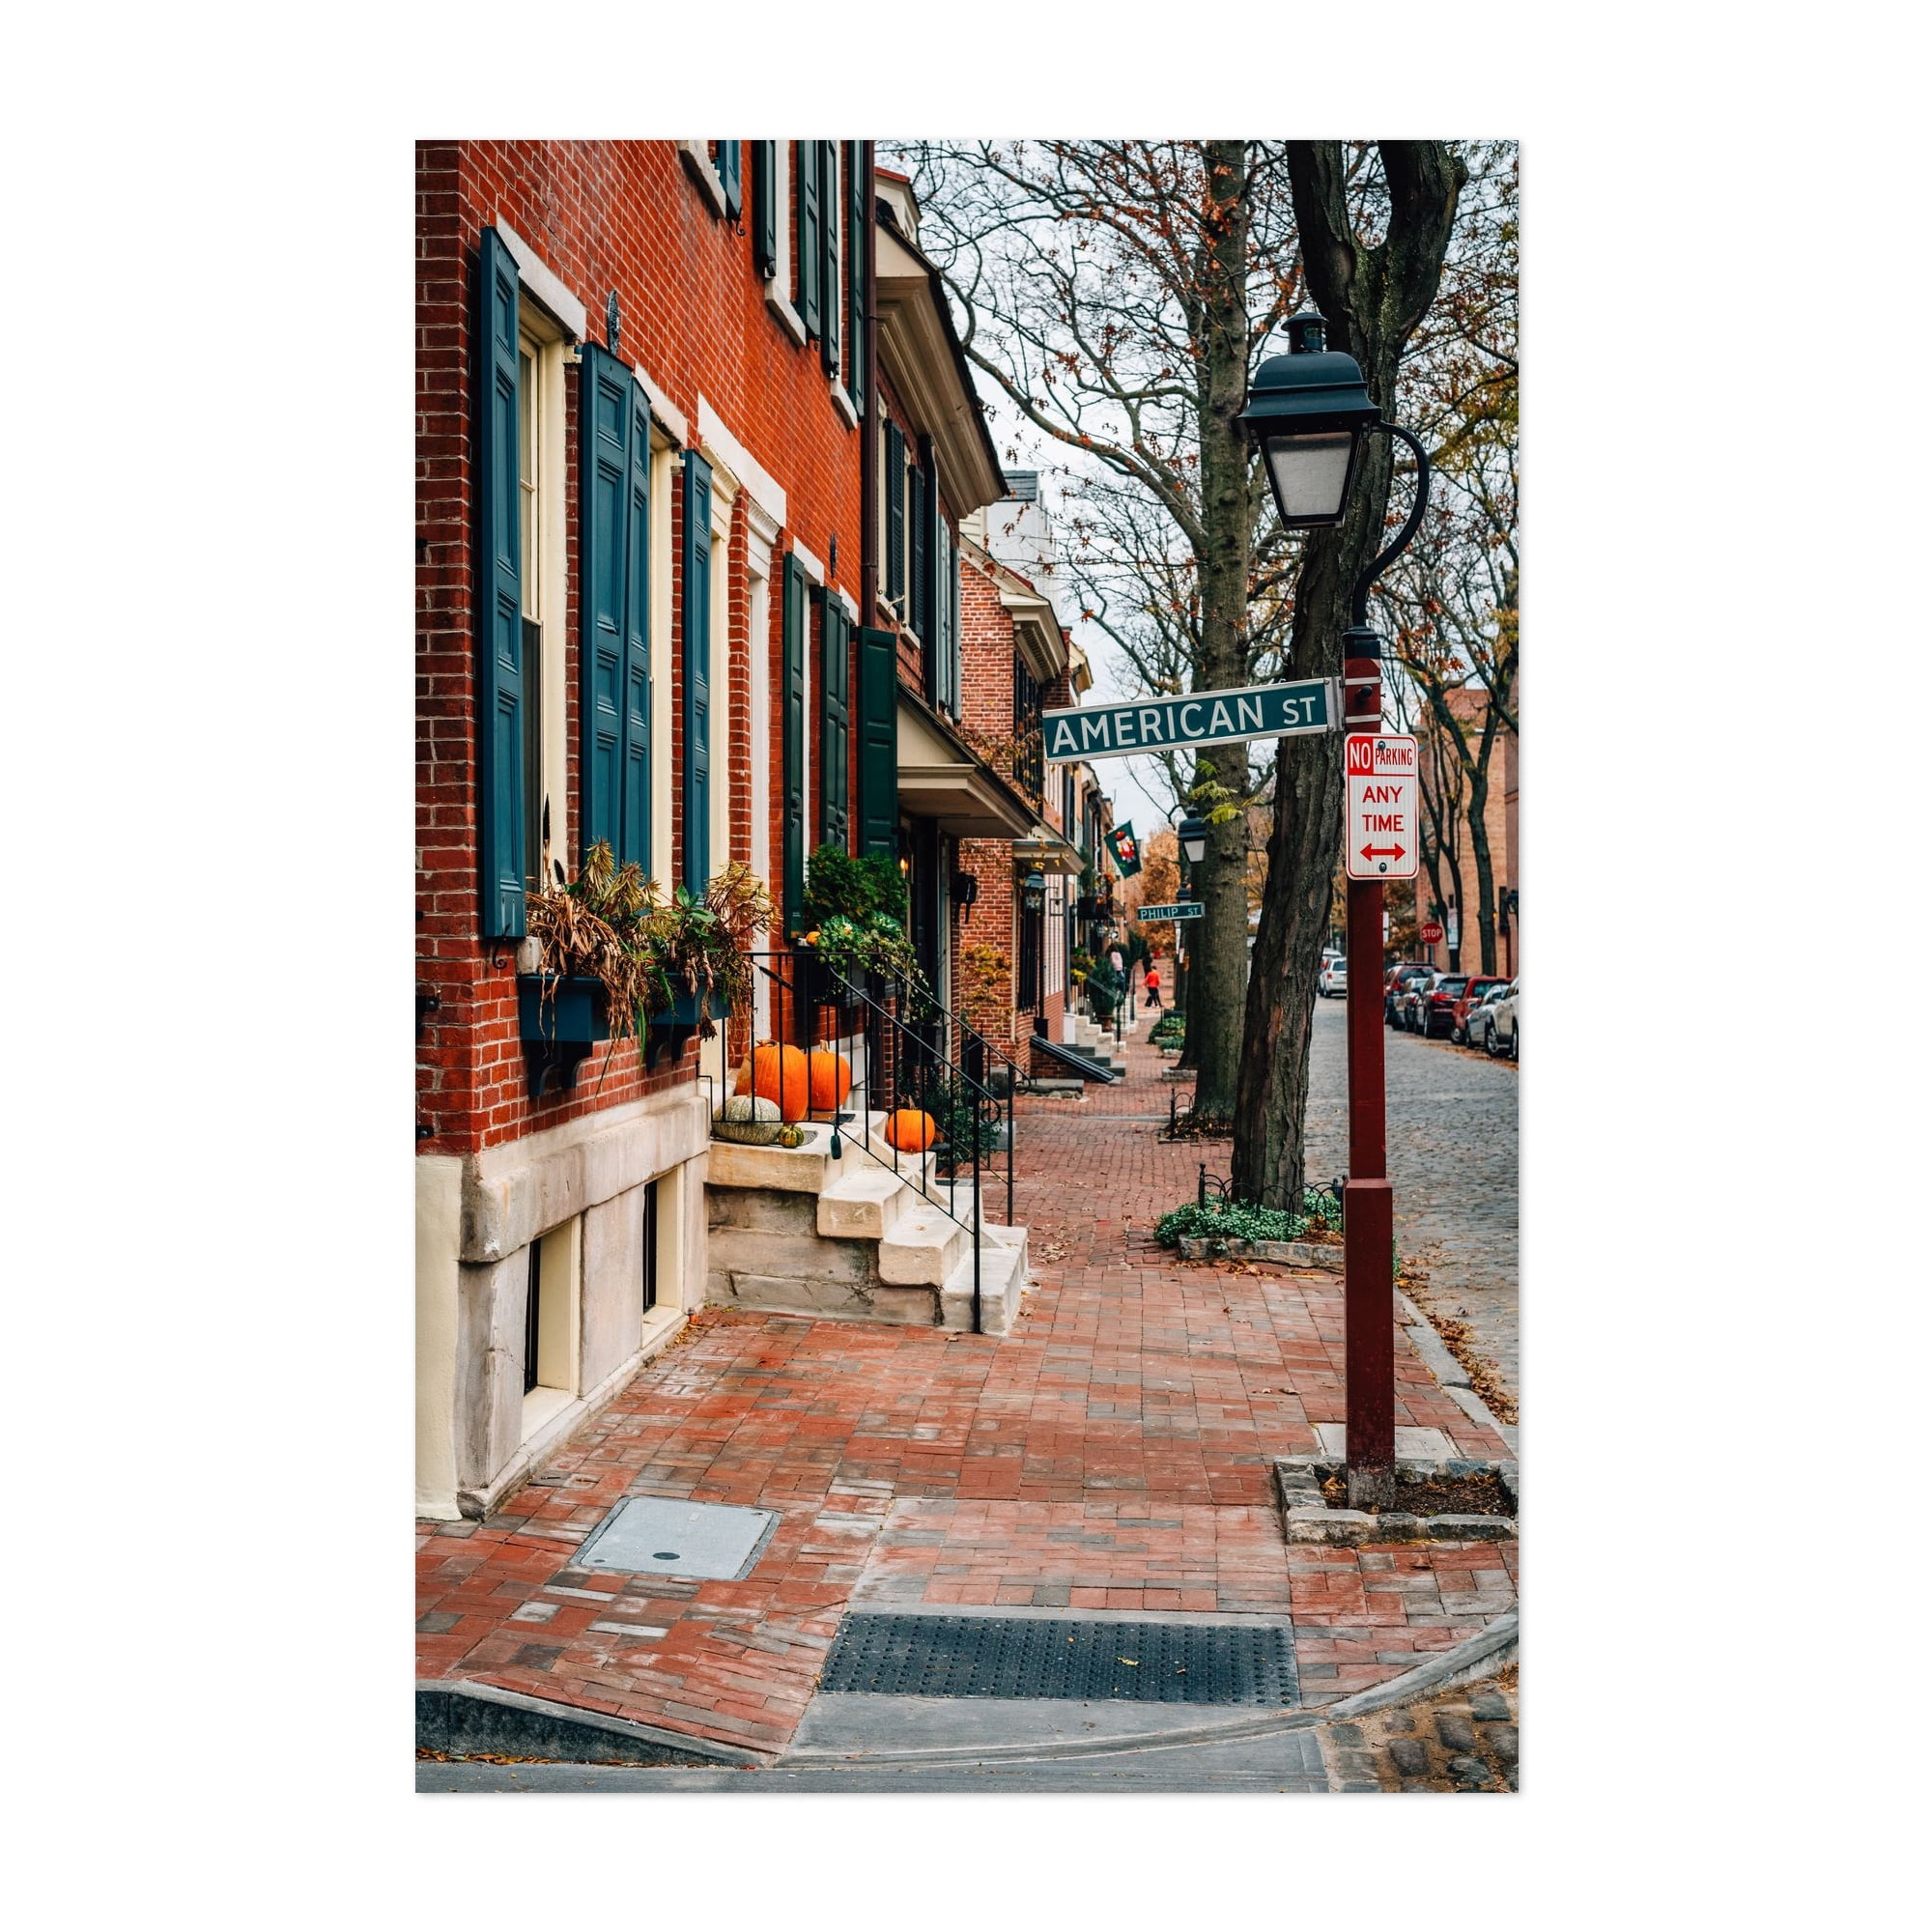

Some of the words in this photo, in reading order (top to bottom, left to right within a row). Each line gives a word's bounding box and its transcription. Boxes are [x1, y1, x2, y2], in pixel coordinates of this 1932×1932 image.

[1052, 696, 1264, 753] AMERICAN
[1282, 696, 1316, 724] ST
[1350, 742, 1371, 769] NO
[1375, 746, 1413, 766] PARKING
[1362, 785, 1403, 804] ANY
[1362, 814, 1405, 832] TIME
[1140, 907, 1179, 920] PHILIP
[1187, 907, 1198, 916] ST
[1422, 928, 1441, 938] STOP
